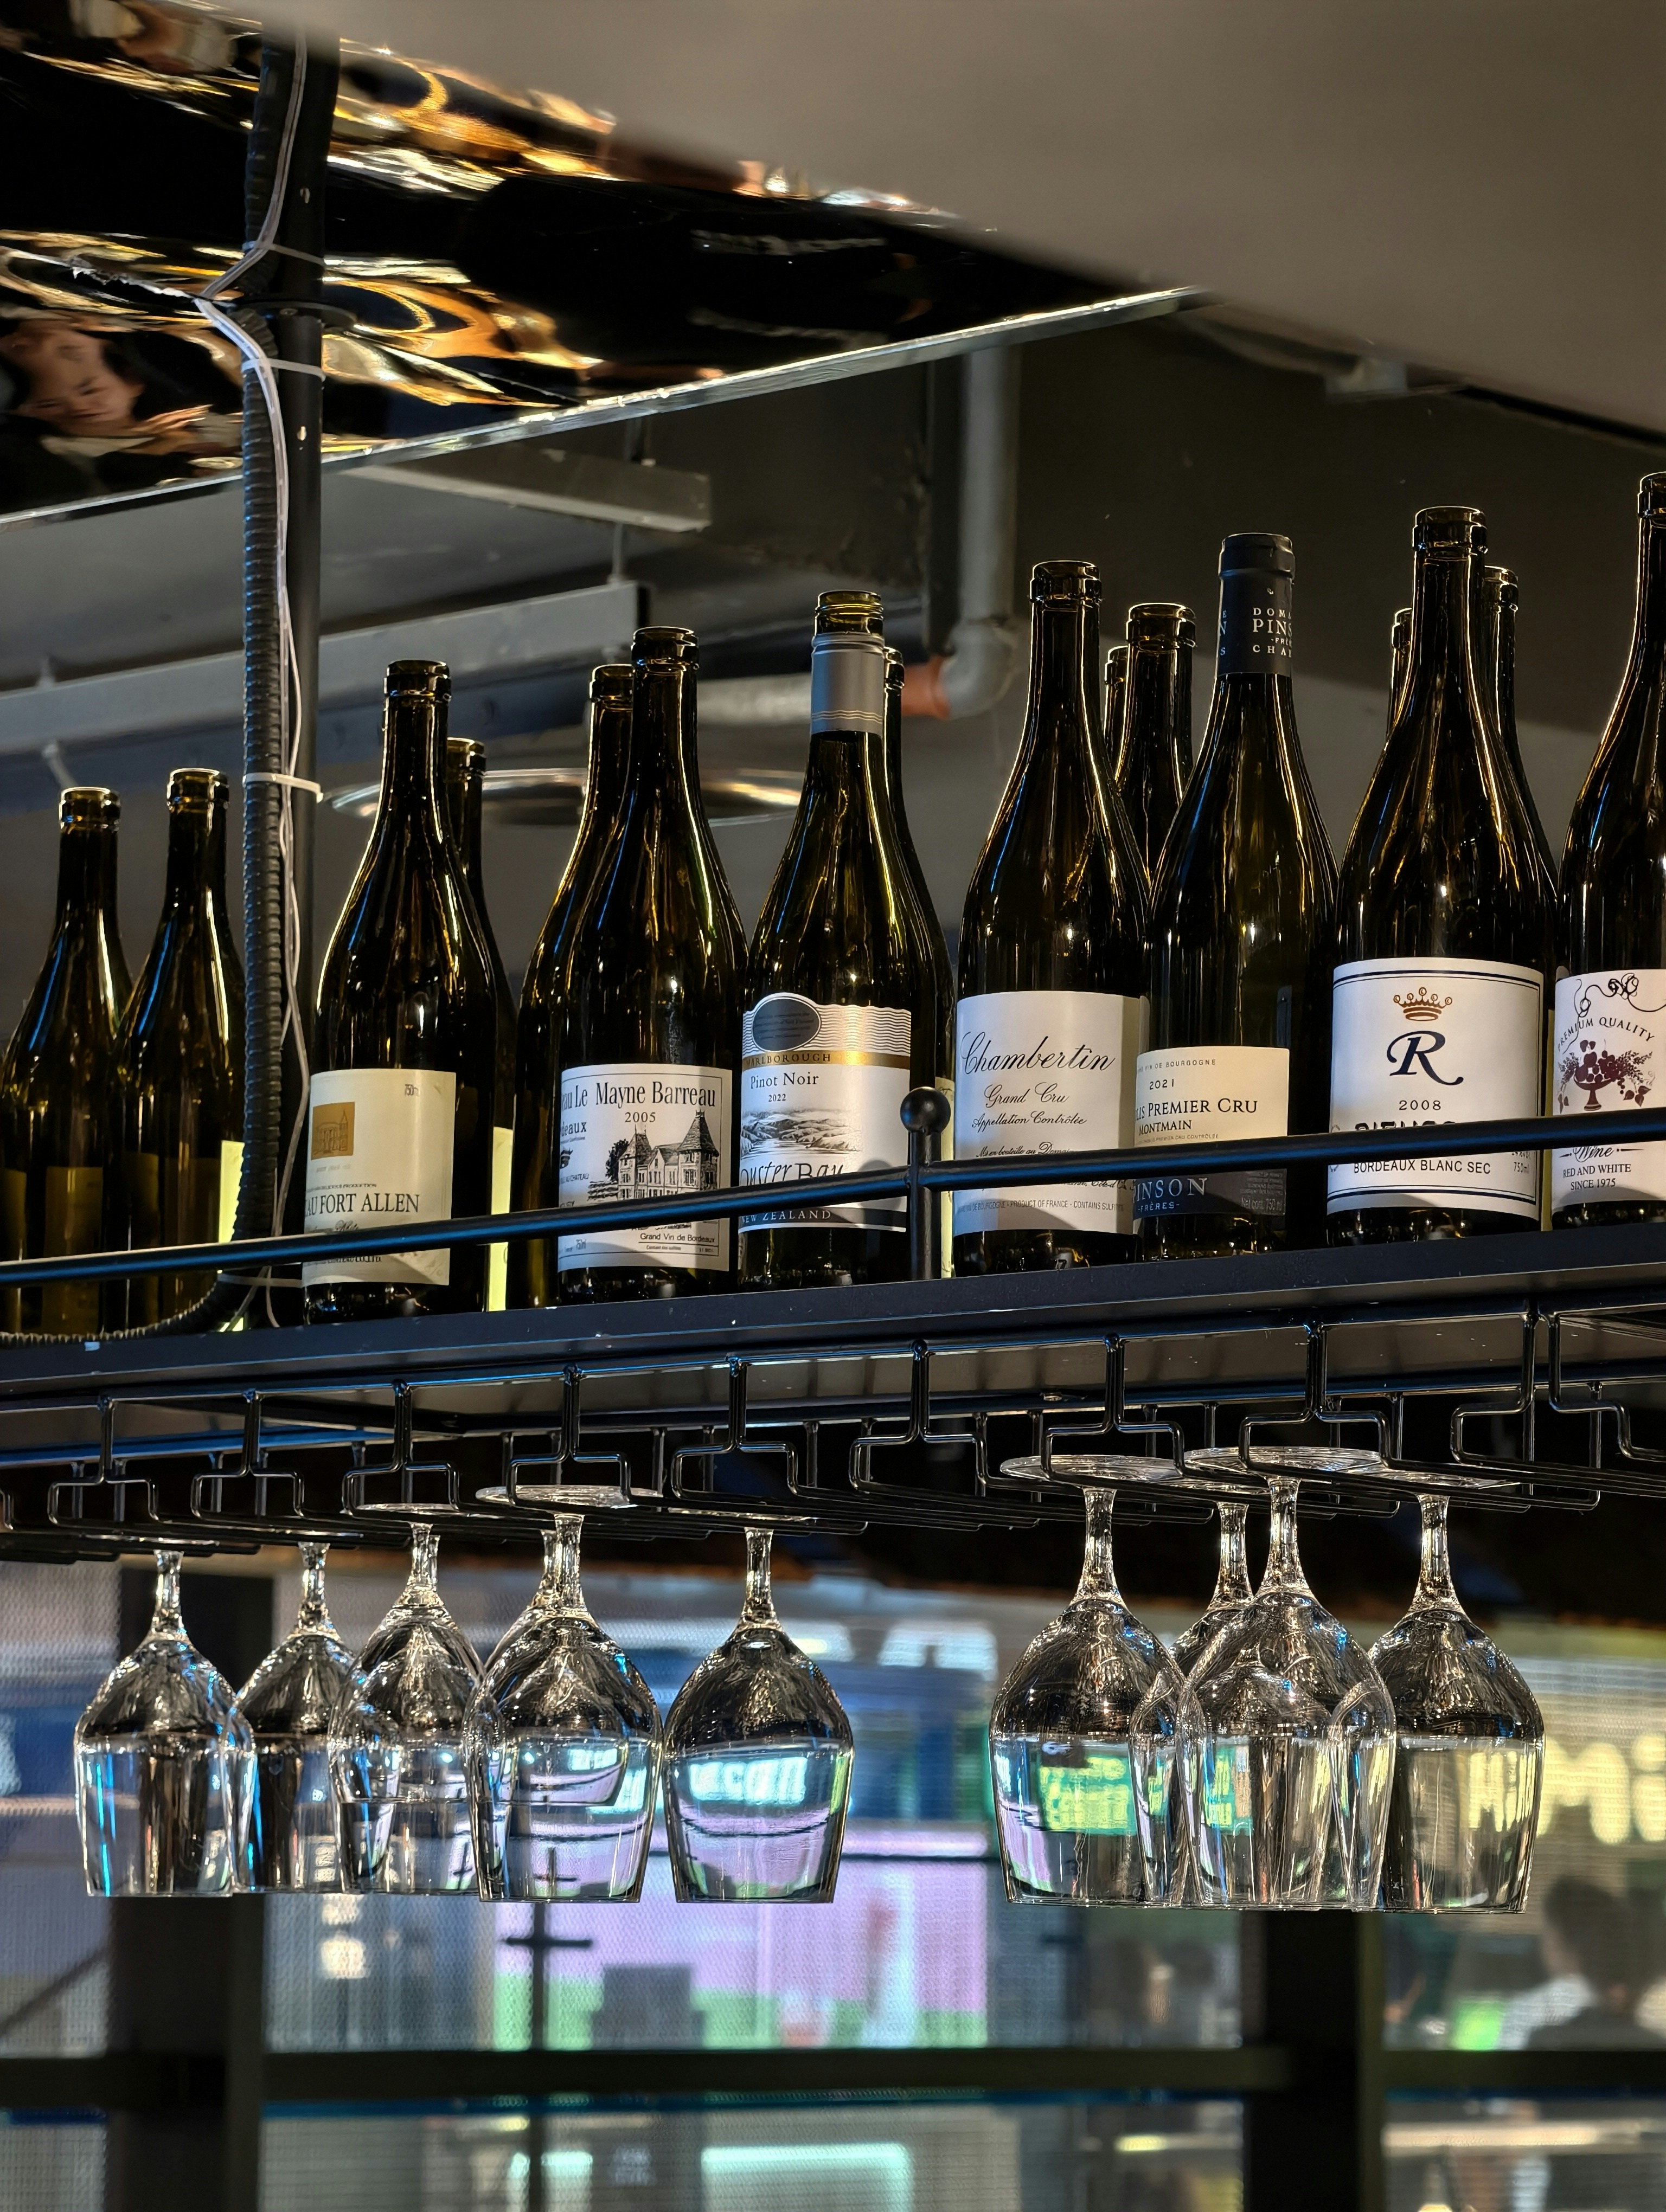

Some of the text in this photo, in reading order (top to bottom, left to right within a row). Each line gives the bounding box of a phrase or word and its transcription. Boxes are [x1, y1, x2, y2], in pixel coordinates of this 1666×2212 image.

[1558, 1017, 1594, 1052] PREMIUM
[1599, 1017, 1655, 1042] QUALITY
[960, 1031, 1116, 1075] Chambertin
[1386, 1030, 1464, 1086] R
[1166, 1059, 1216, 1068] BOURGOGNE
[750, 1071, 819, 1089] Pinot Noir
[1149, 1078, 1175, 1090] 2021
[575, 1085, 588, 1108] Le
[595, 1082, 645, 1109] Mayne
[652, 1081, 716, 1107] Barreau
[768, 1094, 786, 1102] 2022
[984, 1082, 1071, 1108] Grand Cru
[1148, 1100, 1211, 1117] PREMIER
[1218, 1098, 1258, 1113] CRU
[1399, 1099, 1441, 1111] 2008
[624, 1112, 656, 1123] 2005
[972, 1113, 1030, 1133] Appellation
[1138, 1120, 1192, 1136] MONTMAIN
[1573, 1146, 1614, 1163] Wine
[1354, 1159, 1415, 1173] BORDEAUX
[1420, 1159, 1463, 1172] BLANC
[1466, 1161, 1491, 1174] SEC
[1562, 1163, 1631, 1178] RED AND WHITE
[1571, 1178, 1616, 1191] SINCE 1975
[319, 1193, 357, 1214] FORT
[361, 1193, 421, 1213] ALLEN
[1037, 1200, 1045, 1208] OF
[1046, 1200, 1068, 1208] FRANCE
[1073, 1200, 1101, 1210] CONTAINS
[762, 1209, 831, 1221] ZEALAND
